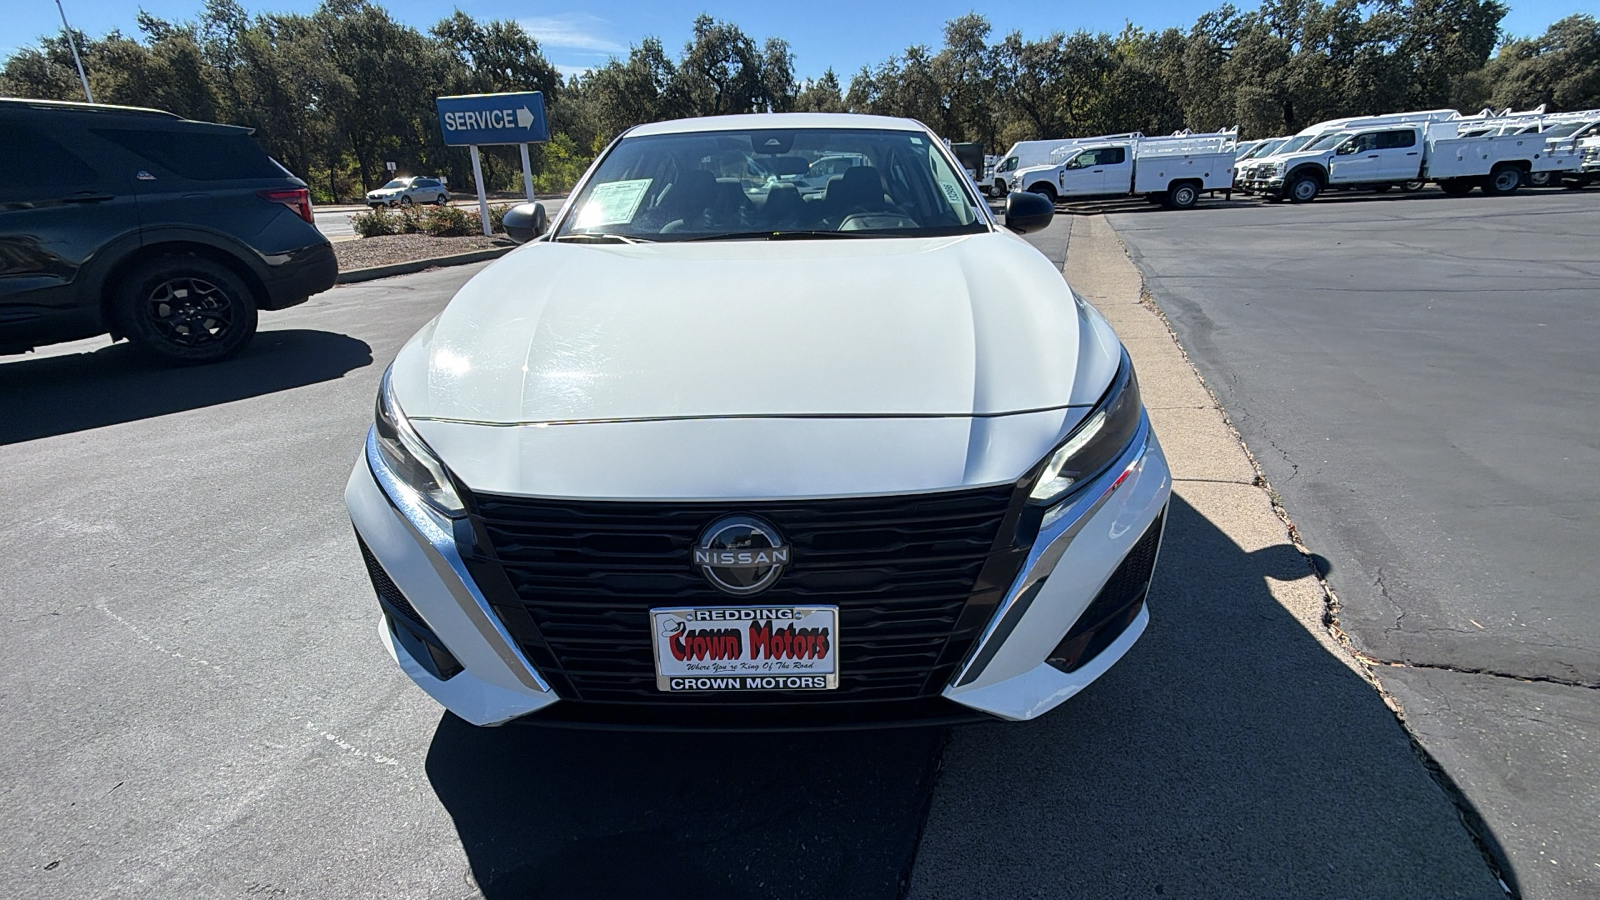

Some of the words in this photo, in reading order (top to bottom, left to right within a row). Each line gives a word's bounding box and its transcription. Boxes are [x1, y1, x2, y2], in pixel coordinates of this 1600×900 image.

[445, 109, 515, 131] SERVICE
[695, 549, 787, 564] NISSAN
[696, 608, 792, 620] REDDING
[669, 624, 742, 662] Crown
[749, 621, 830, 661] Motors
[686, 663, 710, 671] Where
[712, 662, 738, 673] You're
[740, 662, 760, 672] King
[762, 661, 774, 672] Of
[776, 661, 790, 670] The
[793, 661, 815, 670] Road
[671, 678, 740, 690] CROWN
[746, 676, 826, 689] MOTORS
